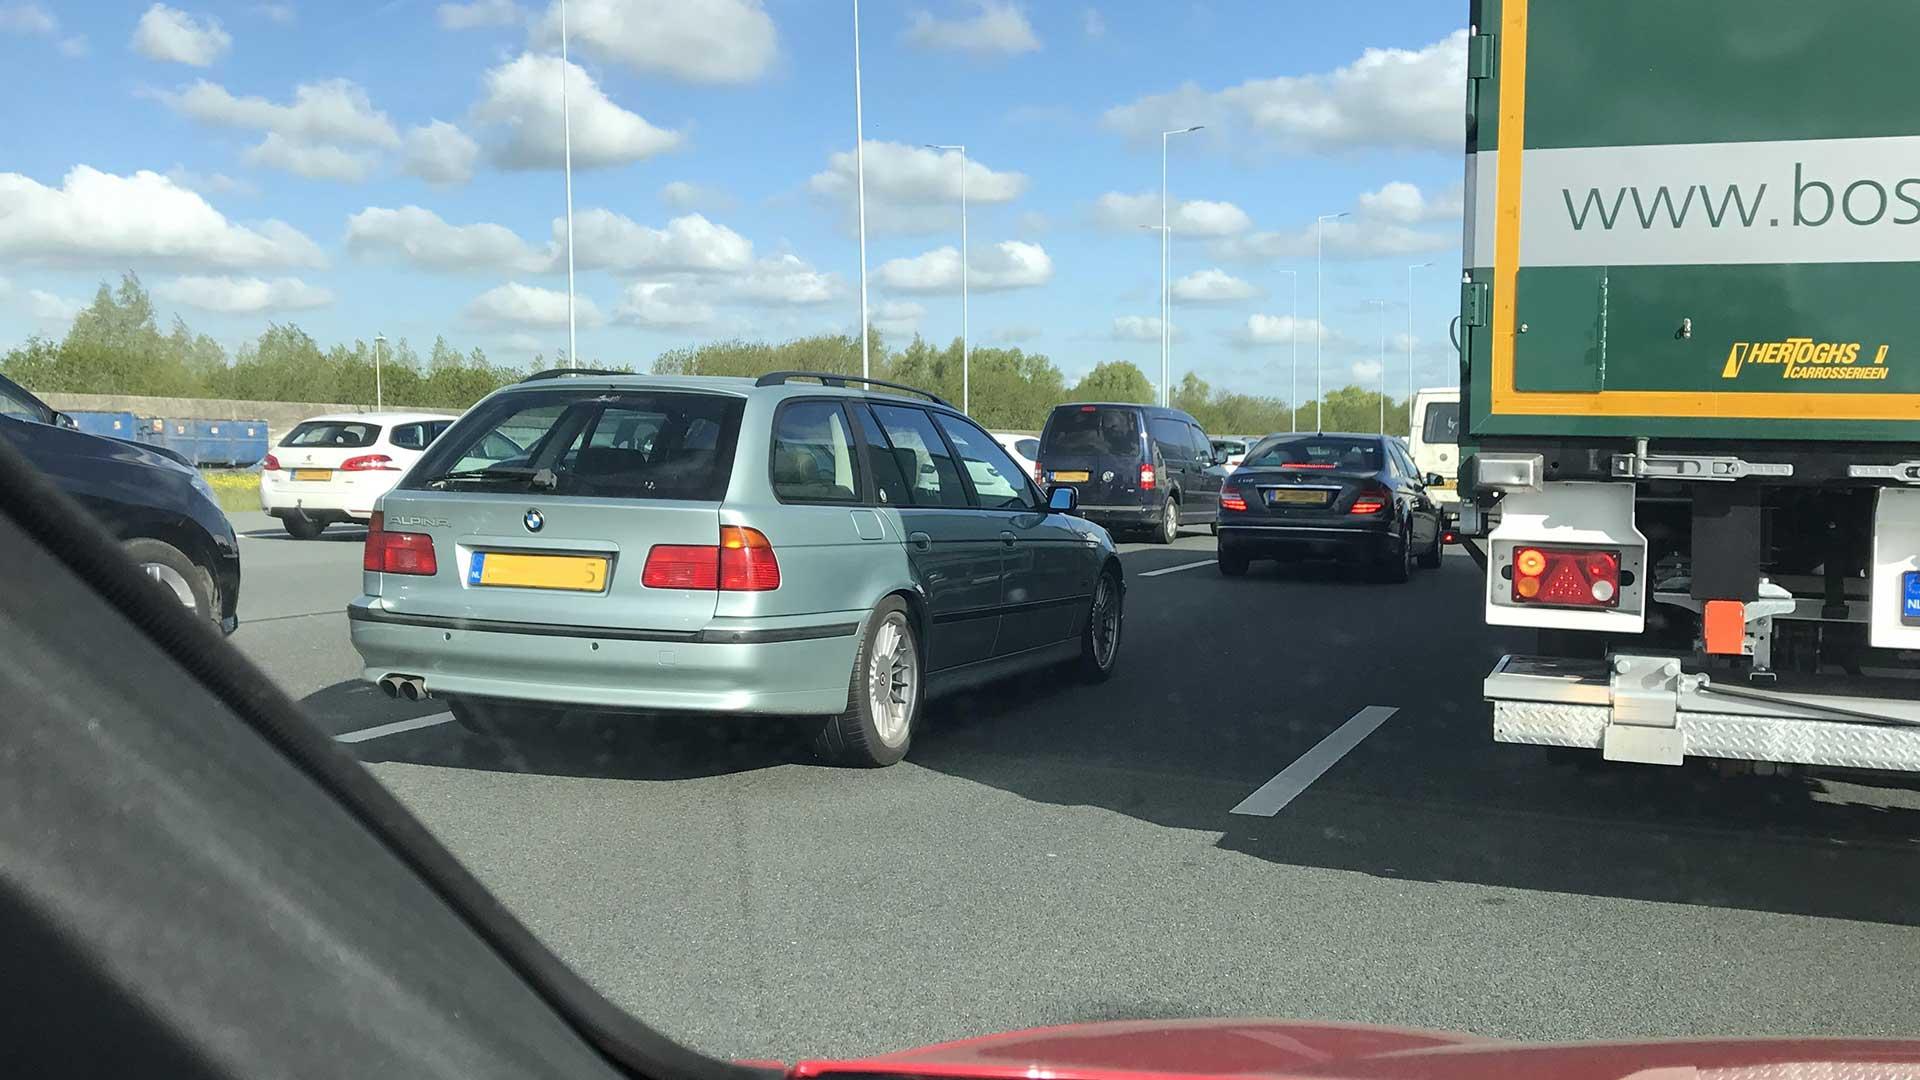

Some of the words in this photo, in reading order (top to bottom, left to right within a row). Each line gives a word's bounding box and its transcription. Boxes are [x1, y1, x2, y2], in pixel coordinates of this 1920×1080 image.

[1562, 162, 1920, 231] www.bos
[1748, 338, 1861, 377] HERTOGHS
[1790, 366, 1889, 380] CARROSSERIEEN
[389, 515, 452, 529] ALPINA
[471, 571, 481, 579] NL
